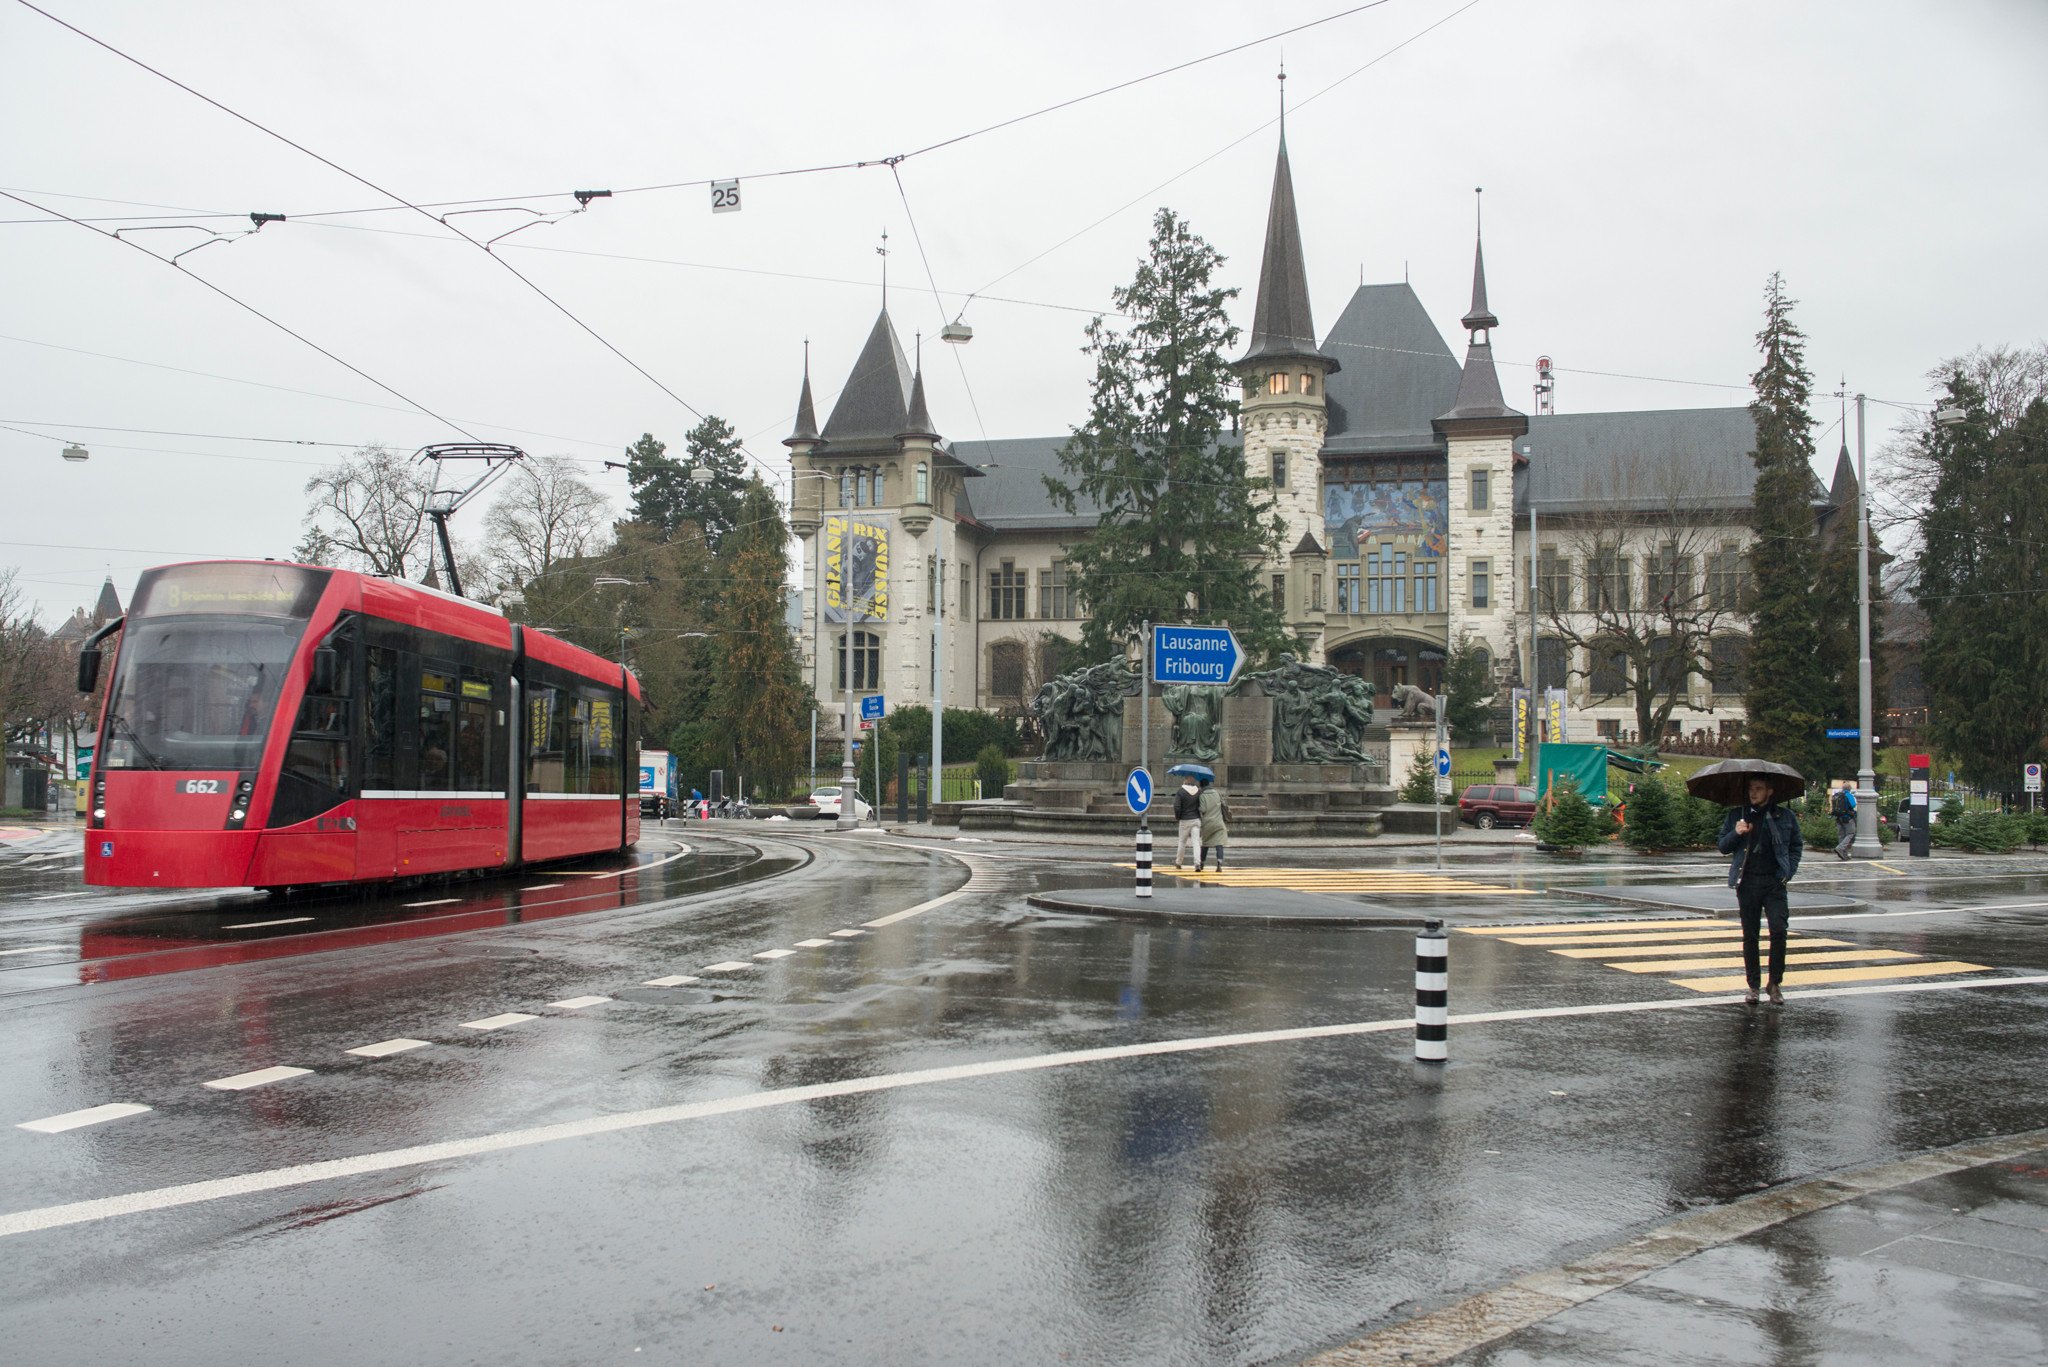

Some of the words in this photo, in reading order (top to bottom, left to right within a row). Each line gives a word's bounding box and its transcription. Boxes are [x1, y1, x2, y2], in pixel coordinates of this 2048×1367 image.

[712, 187, 739, 208] 25
[841, 519, 888, 542] PRIX
[826, 516, 841, 608] GRAND
[874, 541, 888, 621] SUISSE
[168, 585, 180, 608] 8
[1162, 633, 1228, 652] Lausanne
[1165, 657, 1224, 680] Fribourg
[1518, 698, 1527, 753] GRAND
[1551, 698, 1561, 744] UISSE
[186, 779, 219, 794] 662
